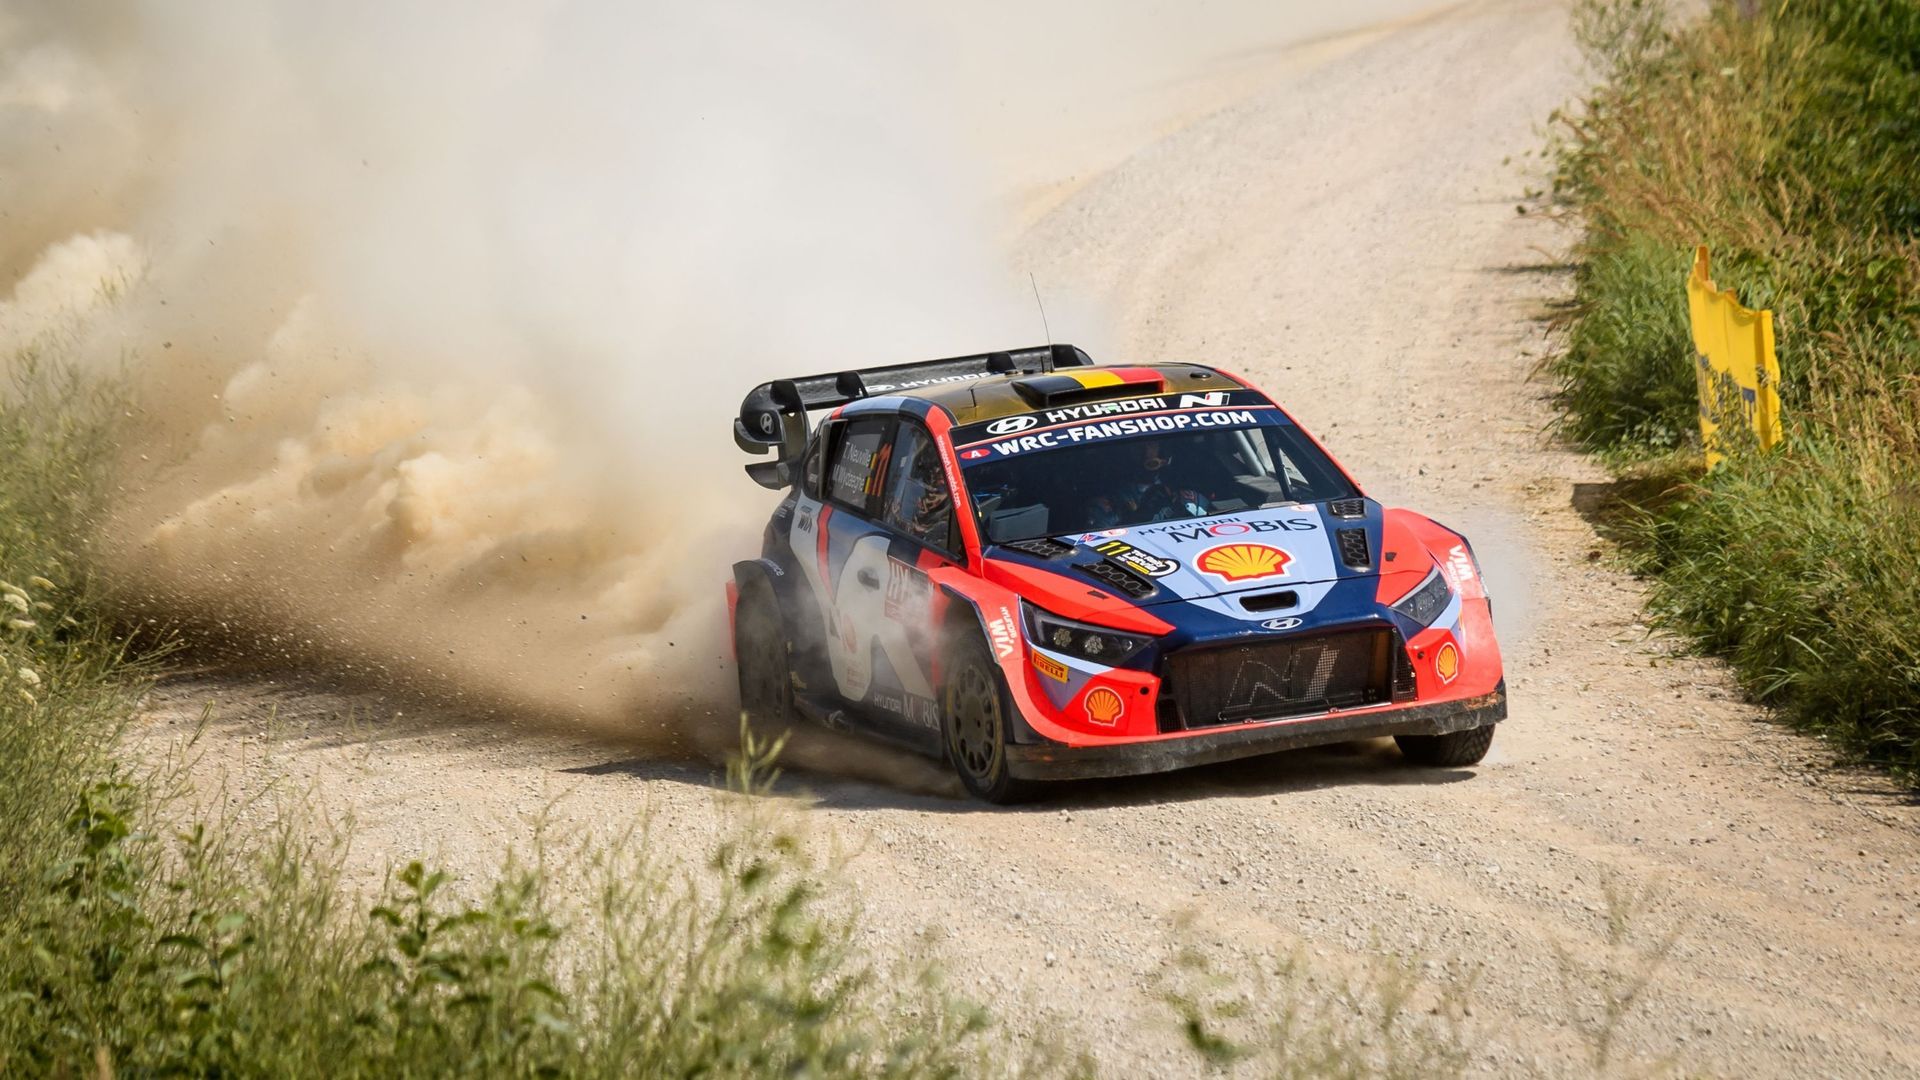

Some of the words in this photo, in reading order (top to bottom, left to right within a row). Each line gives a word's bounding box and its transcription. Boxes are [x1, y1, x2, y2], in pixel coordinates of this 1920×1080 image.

[900, 371, 991, 388] HYUNDA
[1045, 396, 1167, 424] HYUNDAI
[1179, 391, 1230, 409] N
[992, 410, 1257, 457] WRC-FANSHOP.COM
[871, 443, 893, 497] 11
[1137, 517, 1243, 537] HYUNDAI
[1169, 518, 1318, 544] MOBIS
[1096, 541, 1132, 556] 11
[1033, 652, 1065, 679] PIRELLI
[903, 693, 941, 732] MBIS
